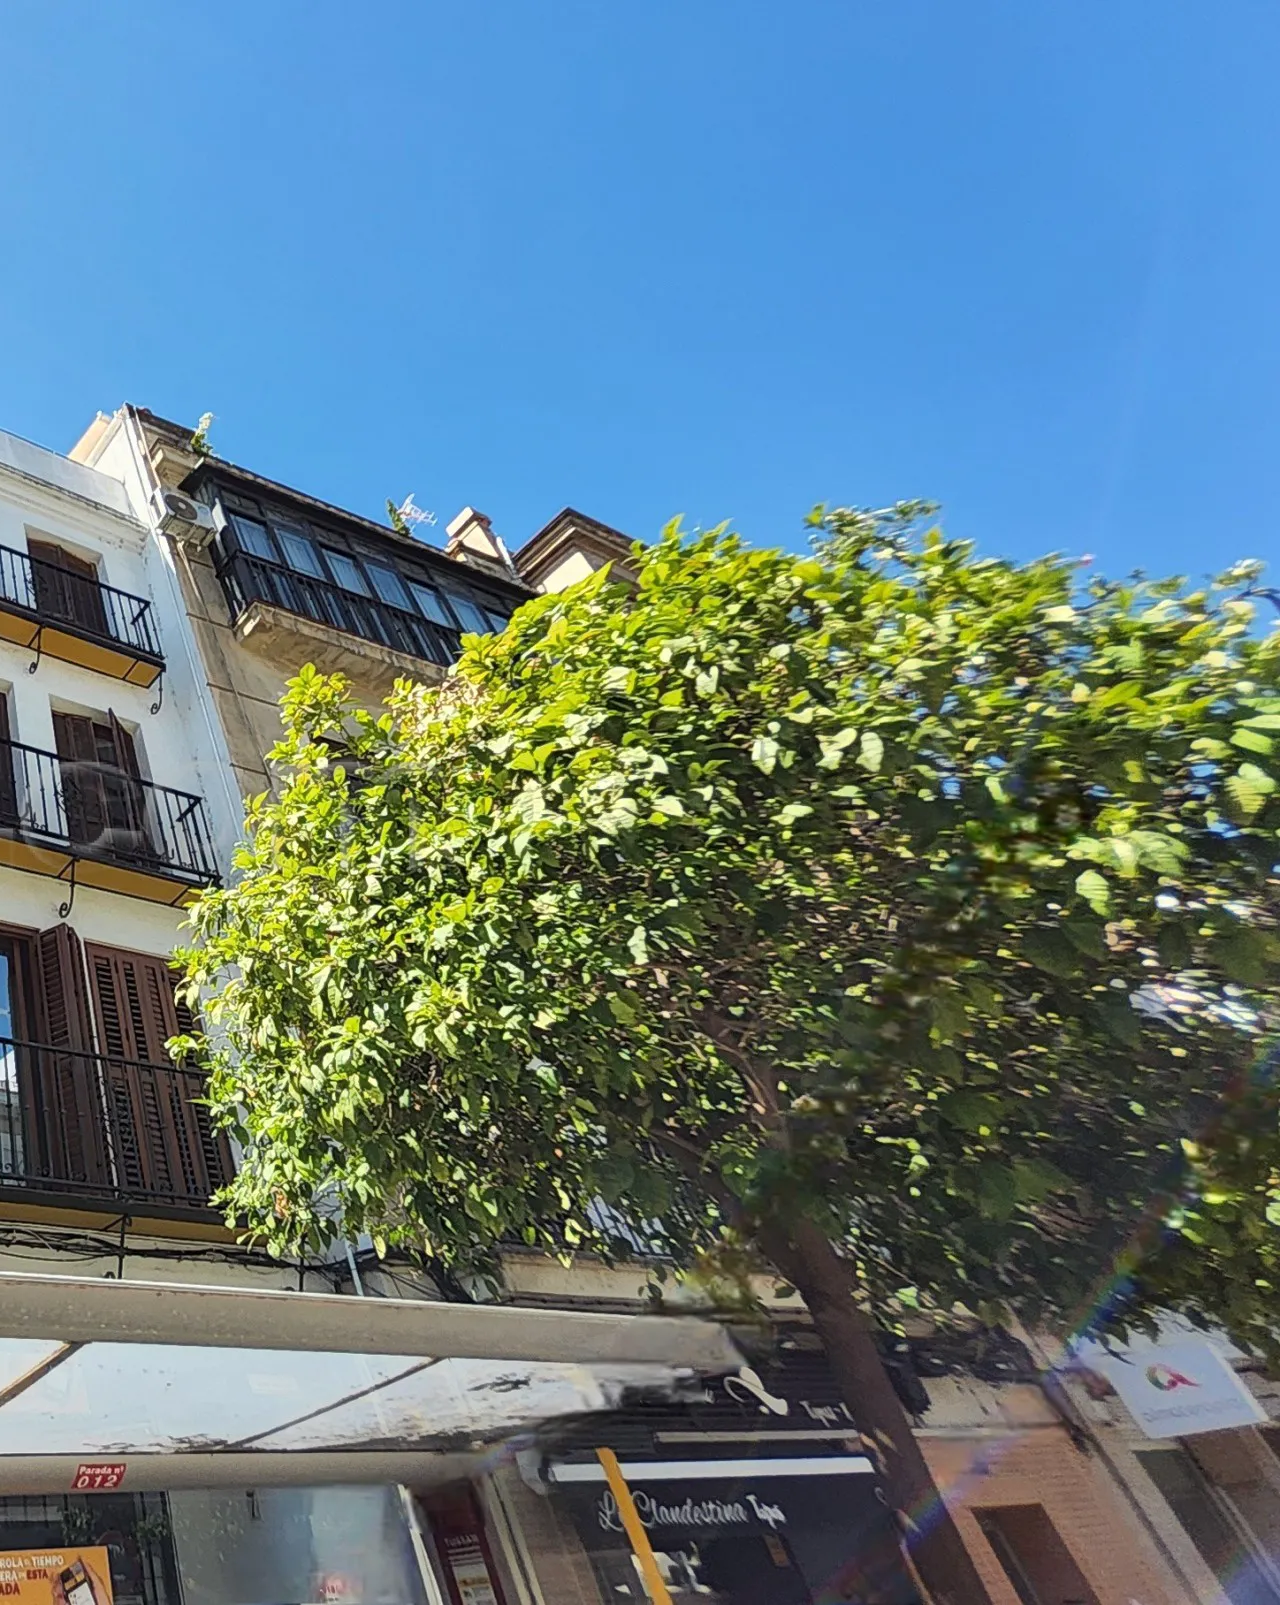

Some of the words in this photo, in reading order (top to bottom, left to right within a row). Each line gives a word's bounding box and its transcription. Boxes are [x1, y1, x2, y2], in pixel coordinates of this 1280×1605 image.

[79, 1465, 112, 1475] Parada
[77, 1475, 118, 1488] 012
[32, 1555, 64, 1567] TIEMPO
[26, 1568, 48, 1581] ESTA
